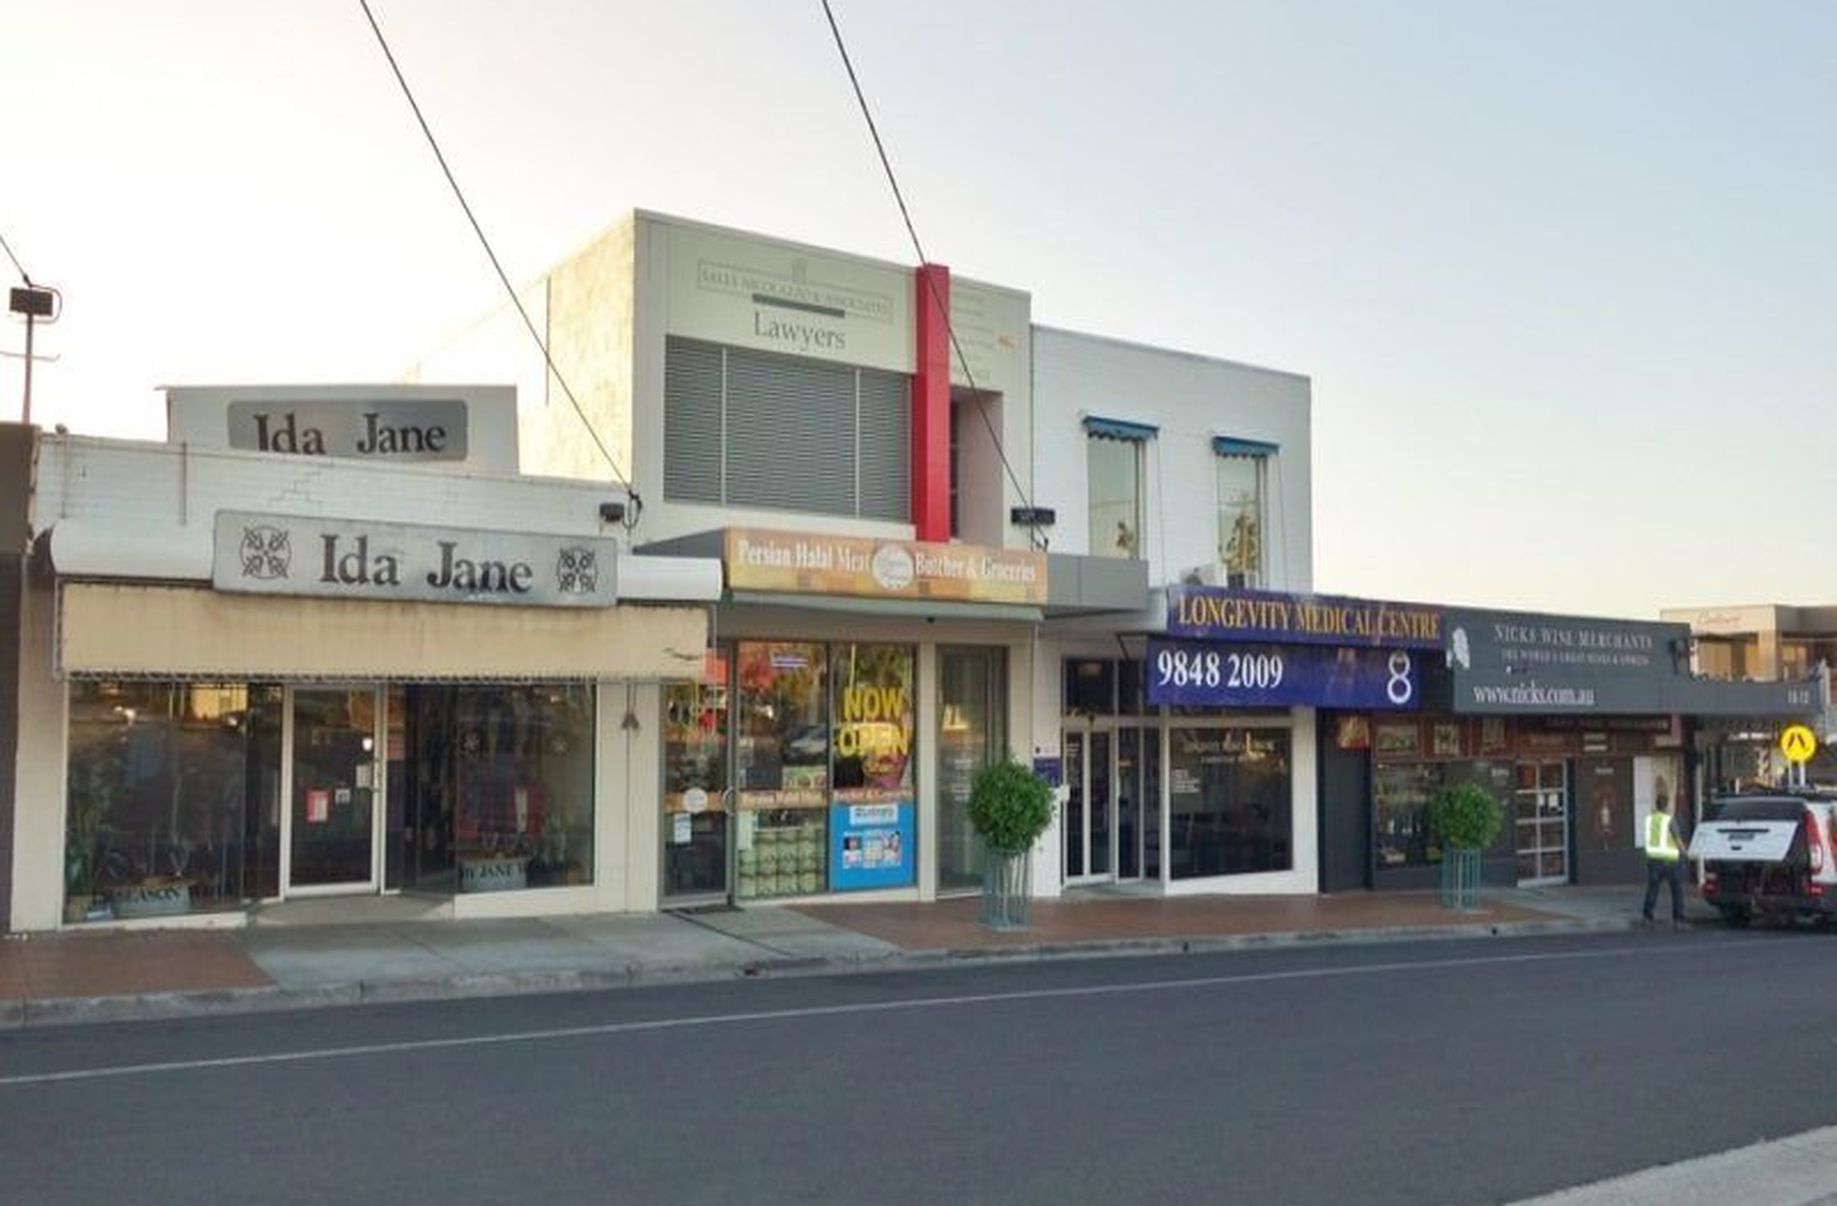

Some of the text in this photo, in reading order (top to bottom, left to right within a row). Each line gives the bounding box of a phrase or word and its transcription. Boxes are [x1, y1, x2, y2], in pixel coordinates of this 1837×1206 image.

[754, 310, 846, 352] Lawyers
[253, 412, 447, 455] Ida Jane
[320, 534, 534, 593] Ida Jane
[736, 539, 791, 567] Persian
[795, 541, 834, 569] Halal
[966, 555, 978, 579] &
[1178, 594, 1441, 640] LONGEVITY MEDICAL CENTRE
[1494, 623, 1653, 649] NICKS WINE MERCHANTS
[1157, 650, 1284, 688] 9848 2009
[843, 686, 904, 722] NOW
[1473, 679, 1595, 705] www.nicks.com.au
[840, 723, 909, 758] OPEN
